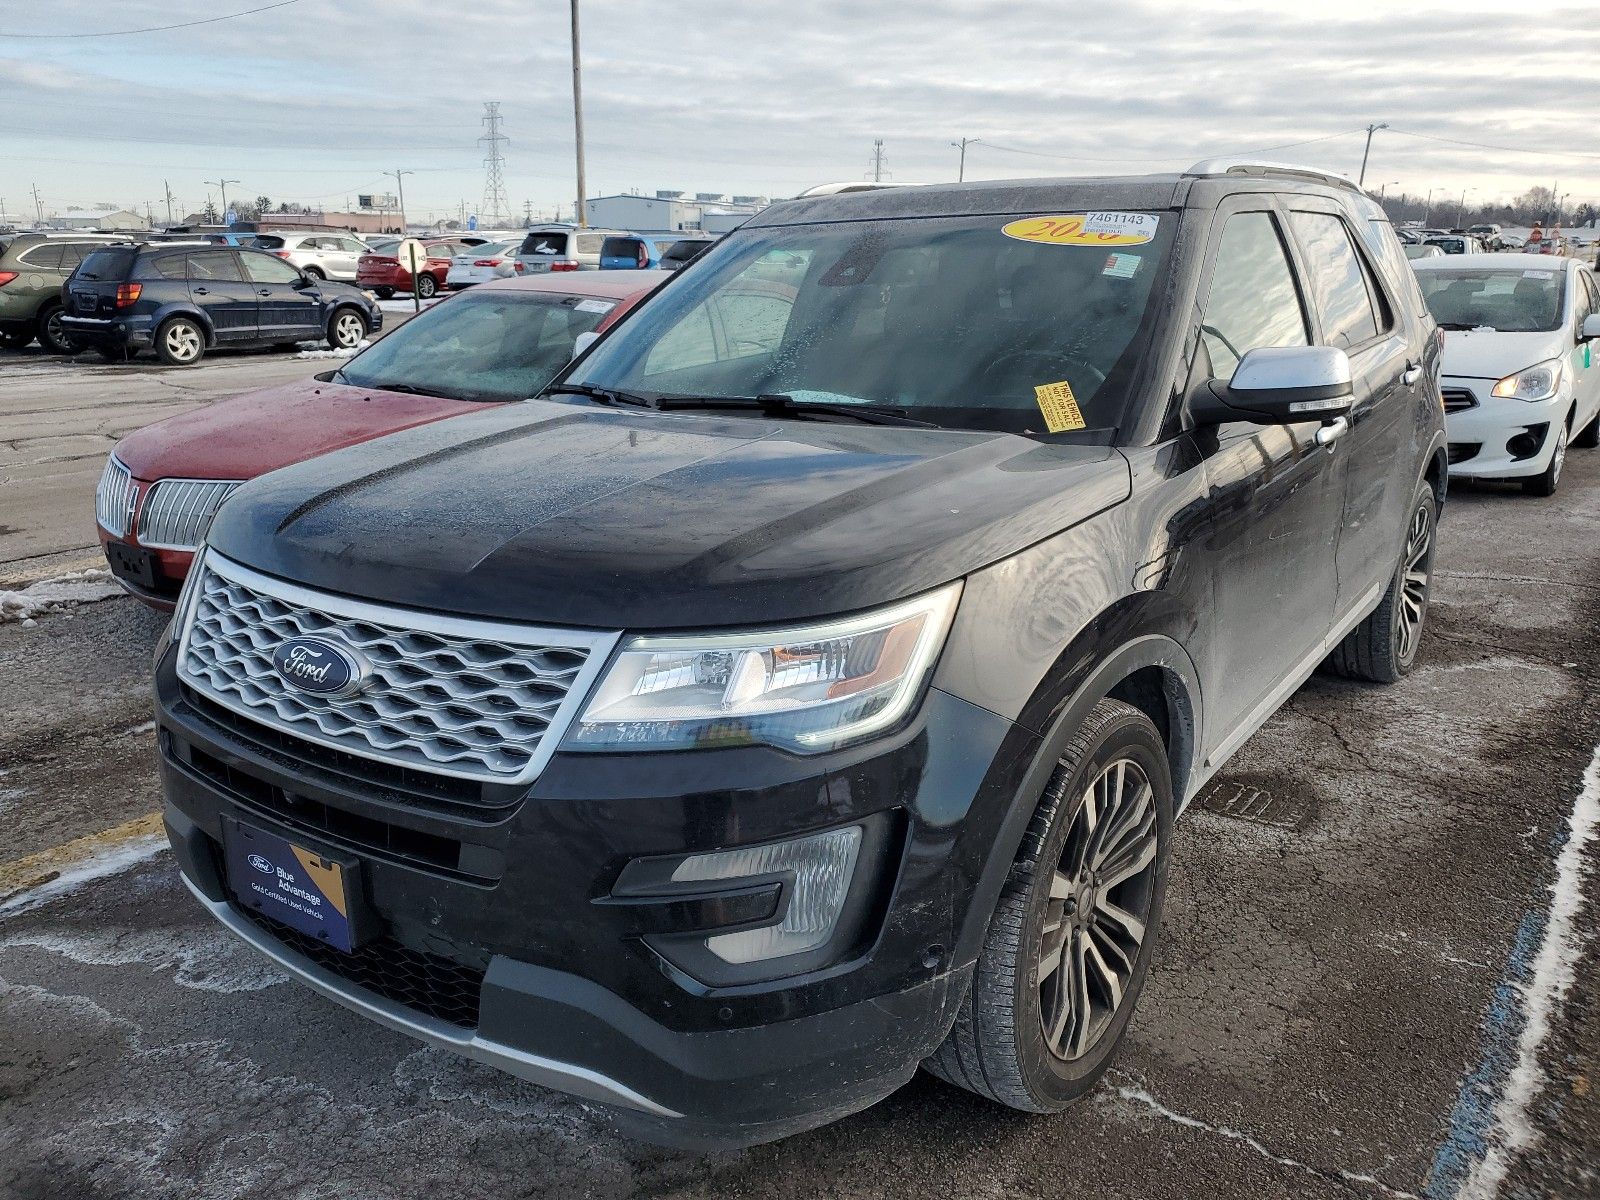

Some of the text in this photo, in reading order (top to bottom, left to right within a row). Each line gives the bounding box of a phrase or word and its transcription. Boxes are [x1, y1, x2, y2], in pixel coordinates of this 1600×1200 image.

[1088, 213, 1144, 225] 7461143
[1023, 221, 1120, 241] 20
[1060, 383, 1072, 399] THIS
[1057, 398, 1067, 410] FOR
[1062, 410, 1073, 426] SALE
[283, 645, 333, 684] Ford
[252, 856, 270, 872] Ford
[276, 866, 295, 883] Blue
[251, 882, 324, 921] Gold Certified Used Vehicle
[278, 878, 321, 906] Advantage
